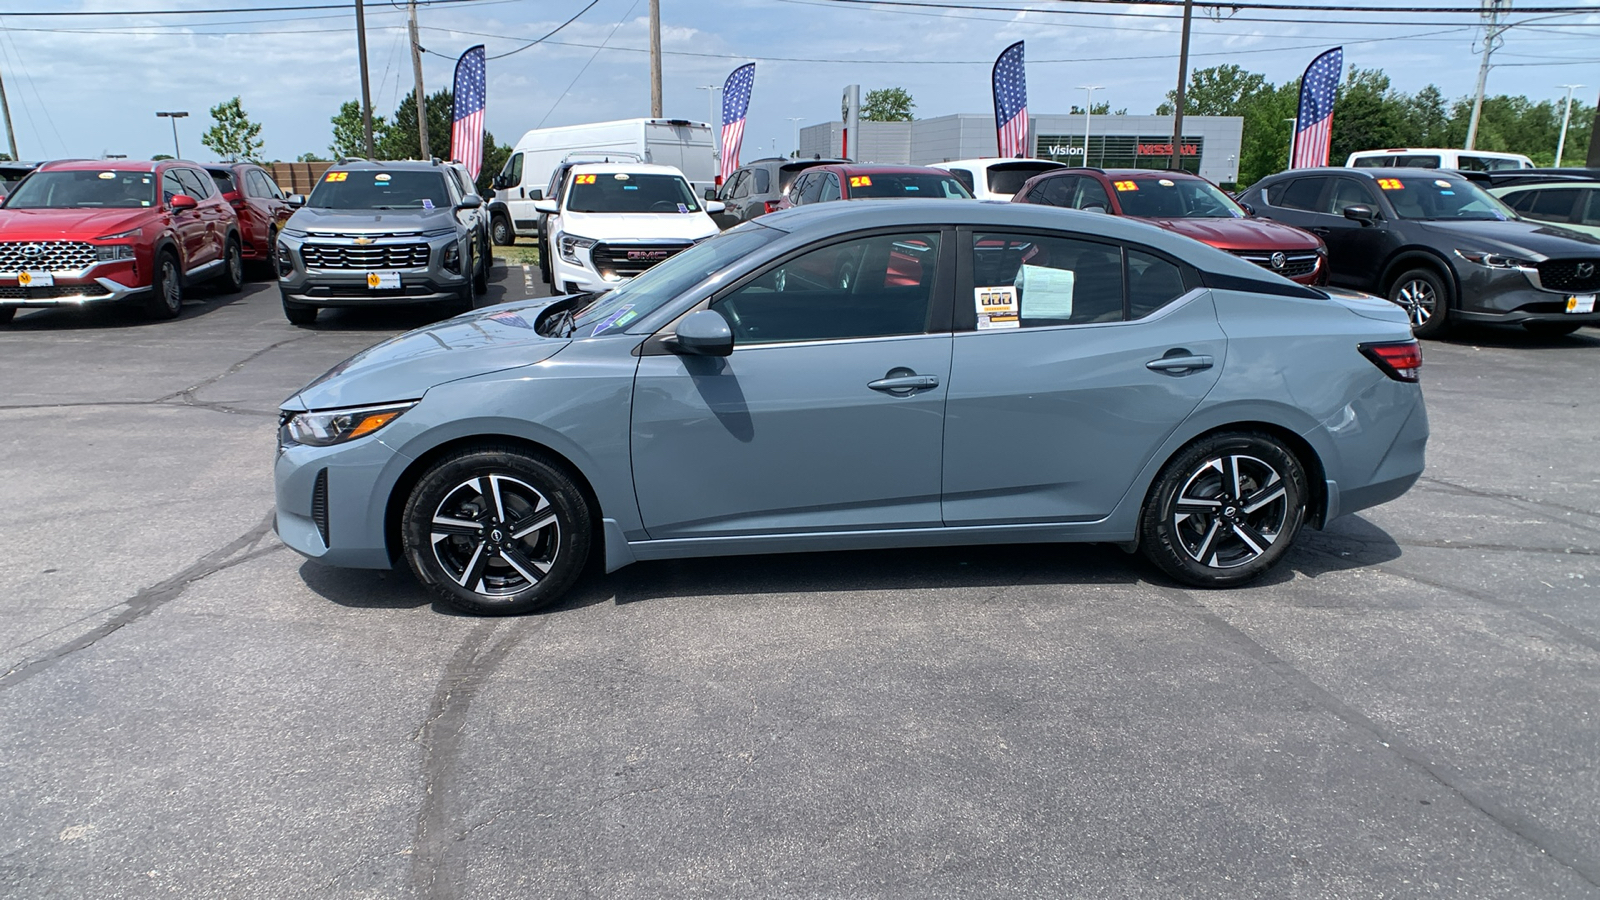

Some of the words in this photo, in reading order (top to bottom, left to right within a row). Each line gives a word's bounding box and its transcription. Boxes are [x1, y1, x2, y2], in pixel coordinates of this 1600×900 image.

[1048, 145, 1084, 155] Vision
[325, 172, 349, 182] 25
[575, 175, 596, 184] 24
[850, 176, 871, 187] 24
[1114, 180, 1136, 191] 23
[1377, 179, 1402, 190] 23
[627, 251, 668, 259] GMC
